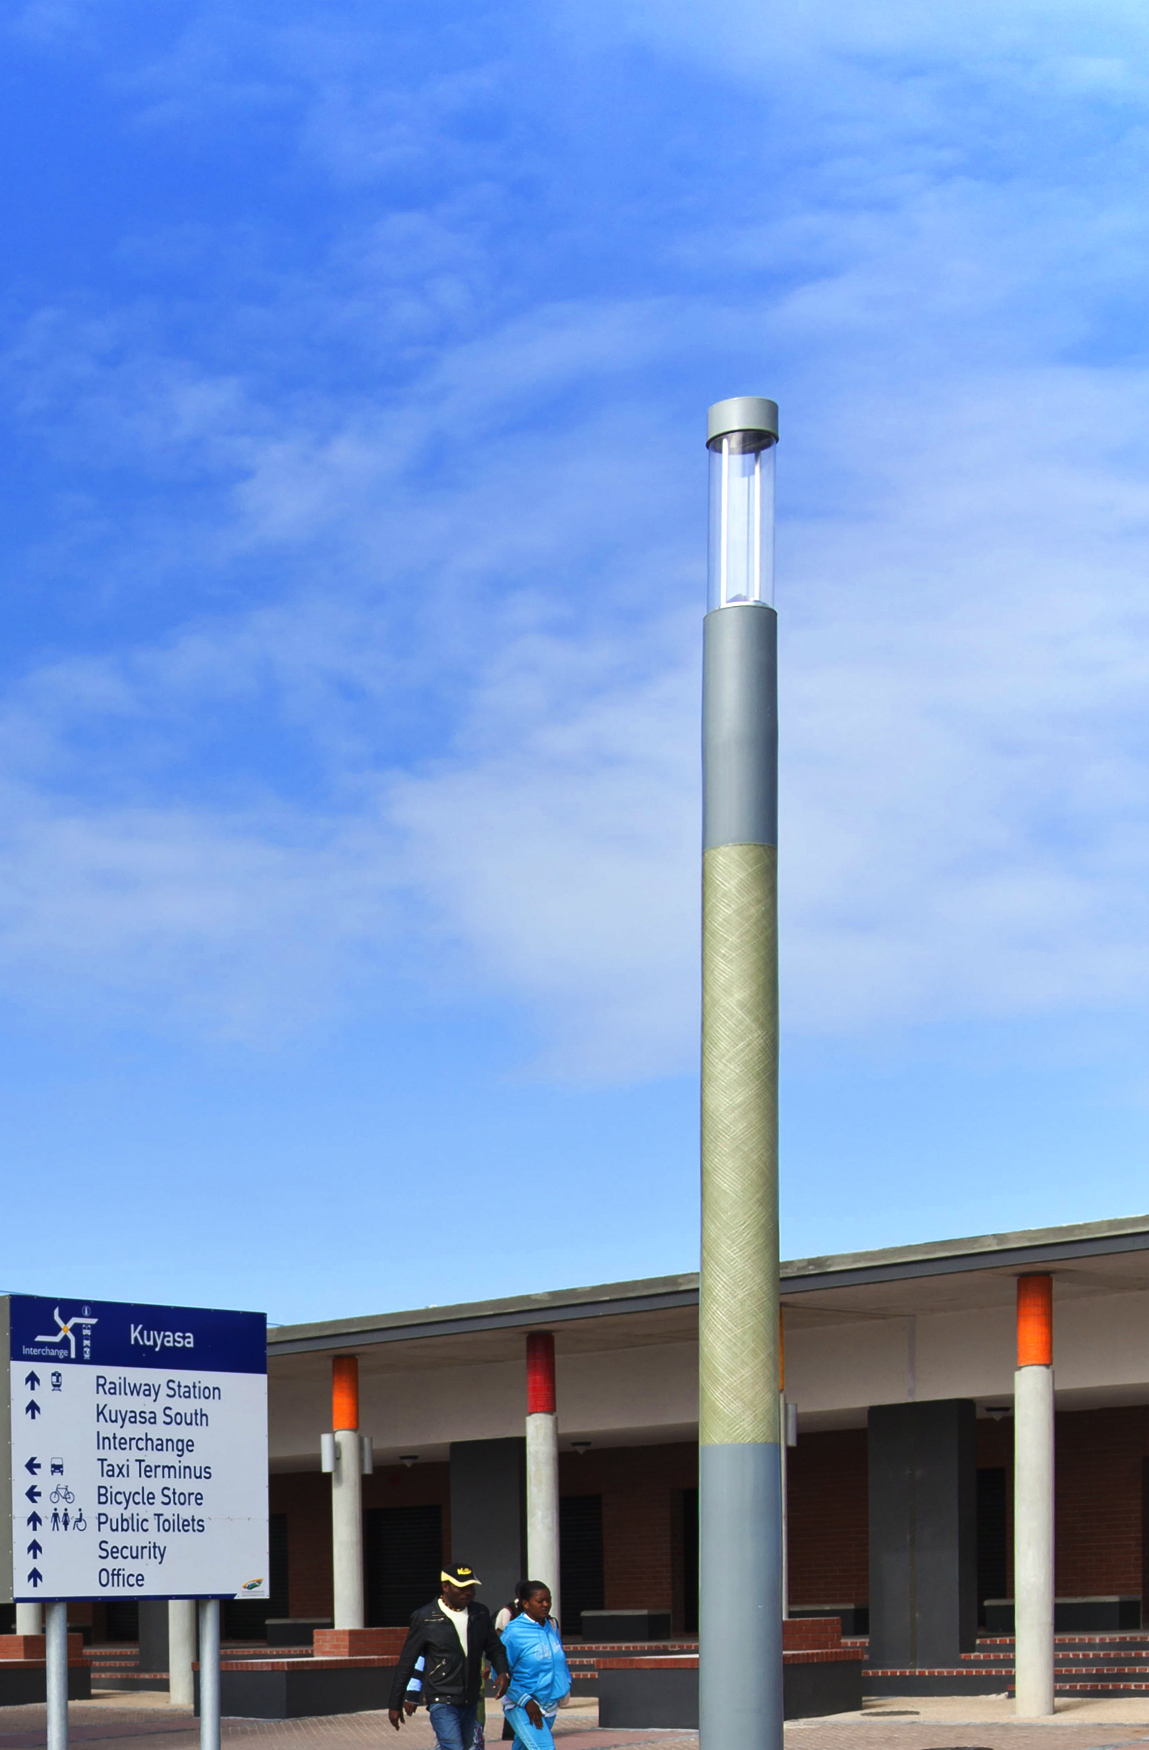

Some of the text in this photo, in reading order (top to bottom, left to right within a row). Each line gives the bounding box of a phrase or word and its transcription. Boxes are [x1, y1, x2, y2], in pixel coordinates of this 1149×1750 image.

[130, 1324, 194, 1351] Kuyasa
[22, 1345, 69, 1359] Interchange
[95, 1375, 221, 1402] Railway Station
[96, 1403, 209, 1429] Kuyasa South
[96, 1430, 195, 1458] Interchange
[97, 1458, 212, 1480] Taxi Terminus
[97, 1485, 203, 1510] Bicycle Store
[97, 1513, 205, 1533] Public Toilets
[98, 1540, 167, 1565] Security
[98, 1567, 145, 1587] Office
